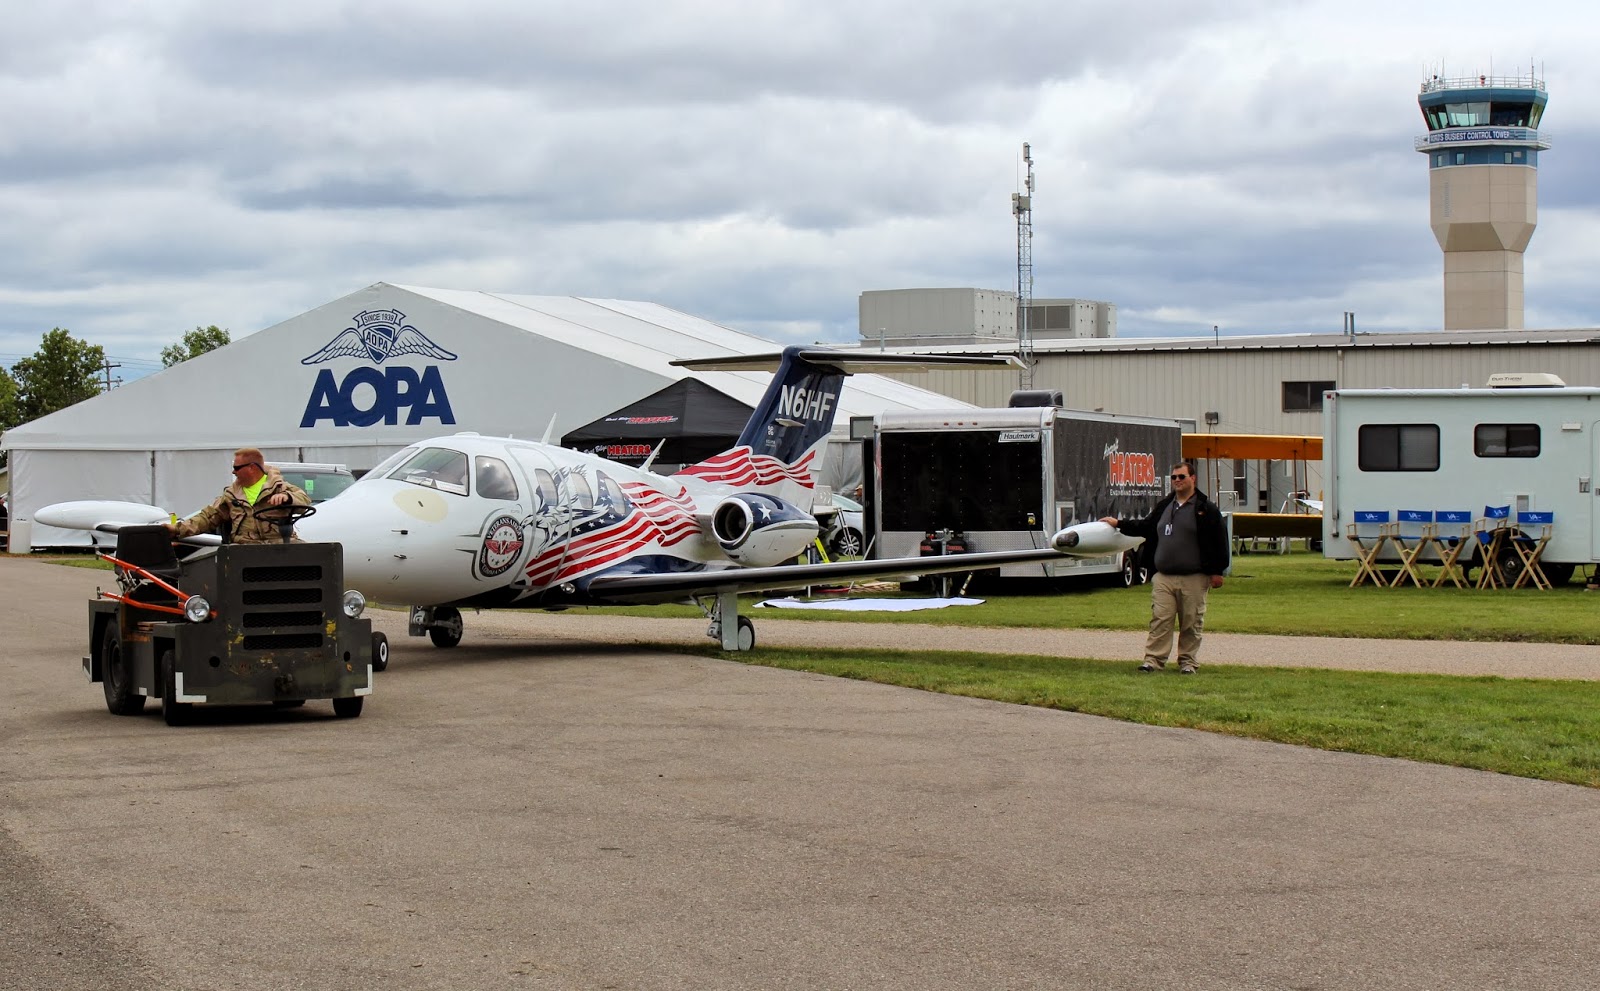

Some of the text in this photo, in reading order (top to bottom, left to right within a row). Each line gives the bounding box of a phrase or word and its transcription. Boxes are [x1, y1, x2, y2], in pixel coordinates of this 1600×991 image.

[1445, 133, 1466, 141] BUSIEST
[1467, 131, 1492, 140] CONTROL
[1492, 131, 1510, 139] TOWER
[363, 313, 394, 323] SINCE 1939
[299, 366, 457, 428] AOPA
[1003, 432, 1036, 441] Haulmark
[607, 444, 651, 456] HEATERS
[1109, 451, 1155, 487] HEATERS
[487, 518, 509, 539] VETERANS
